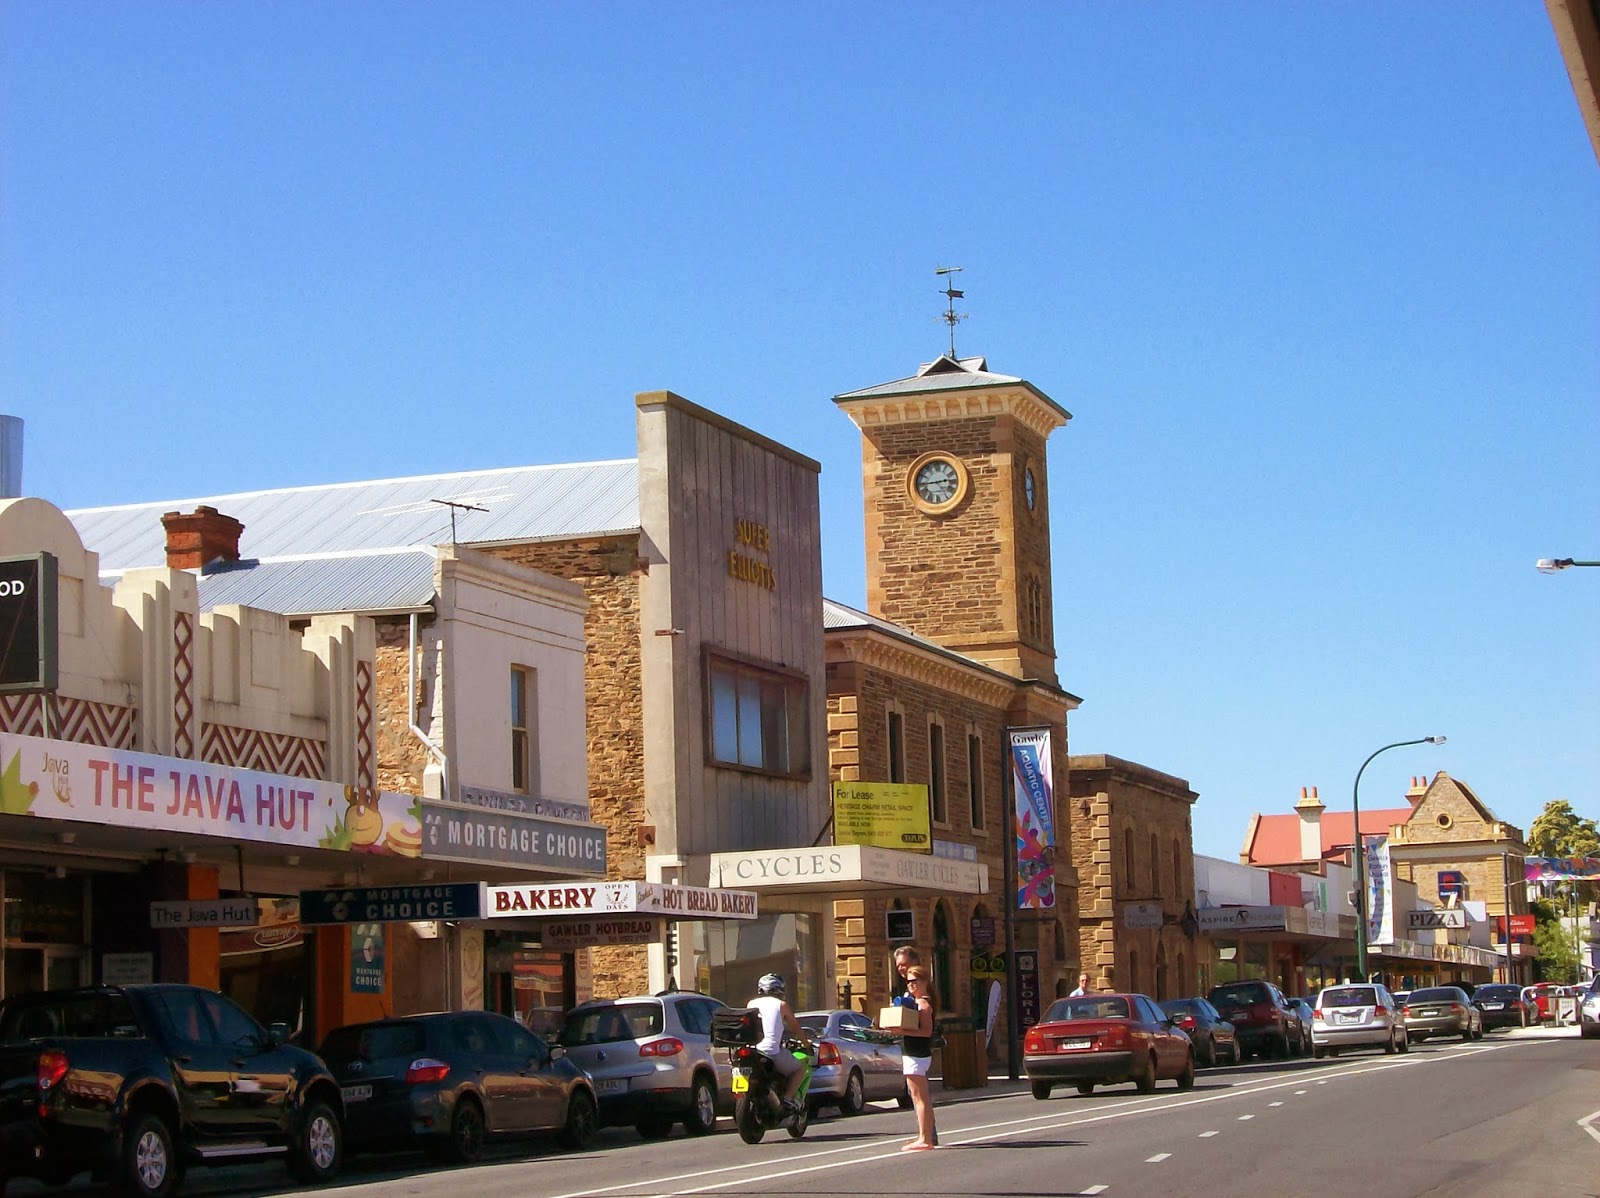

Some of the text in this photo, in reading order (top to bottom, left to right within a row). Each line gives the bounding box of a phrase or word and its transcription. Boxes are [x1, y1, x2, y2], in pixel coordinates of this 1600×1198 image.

[1012, 732, 1048, 745] Gawler
[42, 752, 69, 775] Java
[88, 759, 315, 832] THE JAVA HUT
[836, 788, 849, 799] For
[851, 790, 875, 800] Lease
[1019, 749, 1051, 828] AQUATIC CENTRE
[448, 820, 603, 860] MORTGAGE CHOICE
[736, 853, 842, 879] CYCLES
[897, 860, 929, 881] GAWLER
[933, 863, 959, 885] CYCLES
[366, 887, 454, 901] MORTGAGE
[494, 887, 621, 912] BAKERY 7
[662, 888, 684, 910] HOT
[687, 890, 719, 912] BREAD
[721, 893, 756, 915] BAKERY
[154, 906, 251, 923] The Java Hut
[366, 901, 454, 920] CHOICE
[1201, 915, 1235, 924] ASPIRE
[1409, 912, 1460, 927] PIZZA
[549, 920, 652, 937] GAWLER HOTBREAD
[355, 976, 382, 987] CHOICE
[1021, 973, 1036, 1028] FLORIS
[735, 1078, 745, 1089] L
